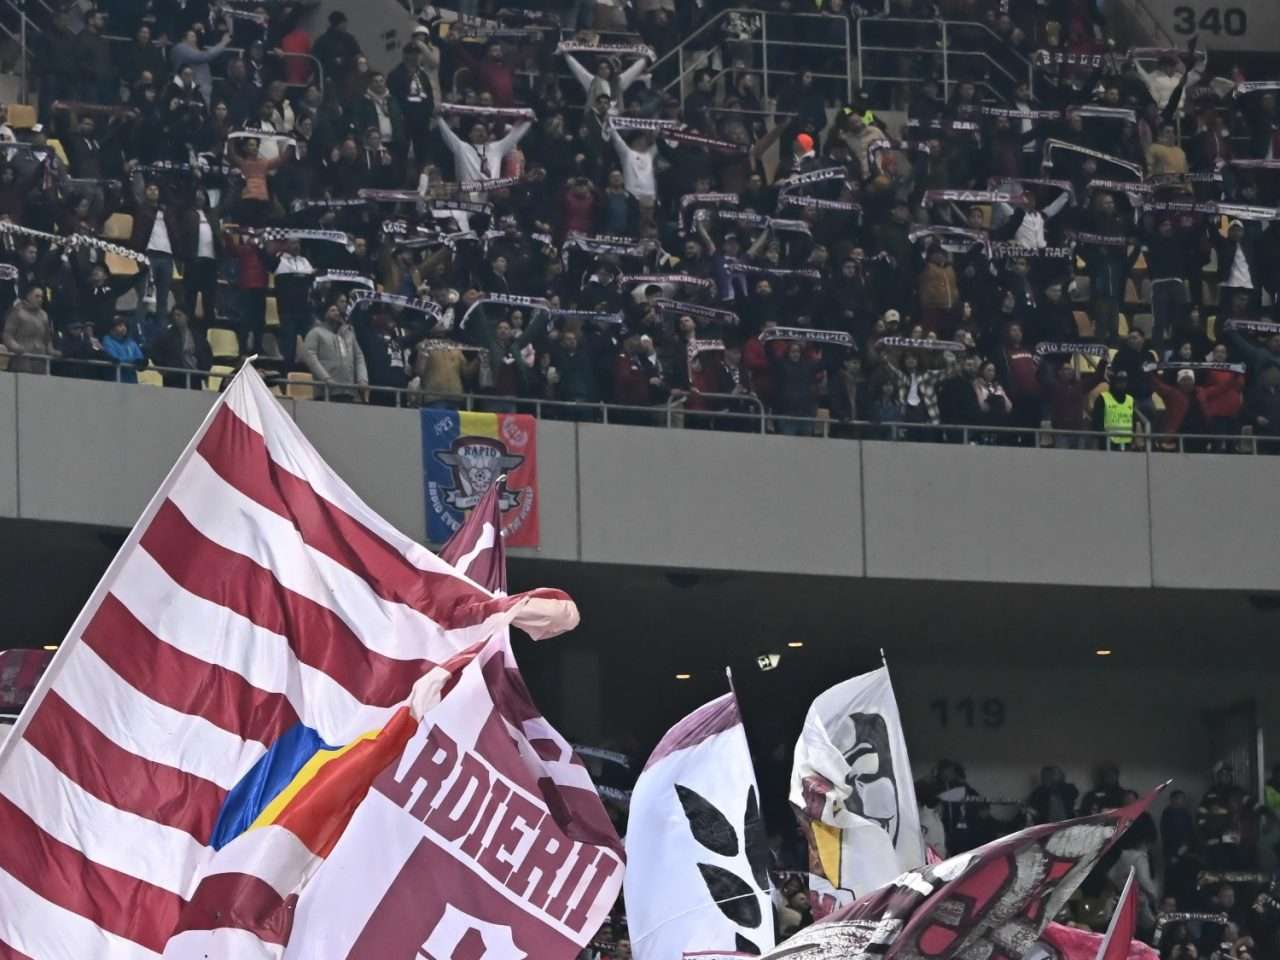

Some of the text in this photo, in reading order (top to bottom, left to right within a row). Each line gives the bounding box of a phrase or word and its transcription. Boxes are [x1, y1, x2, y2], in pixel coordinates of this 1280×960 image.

[1172, 7, 1247, 37] 340
[931, 697, 1007, 728] 119
[373, 724, 620, 935] RDIERII
